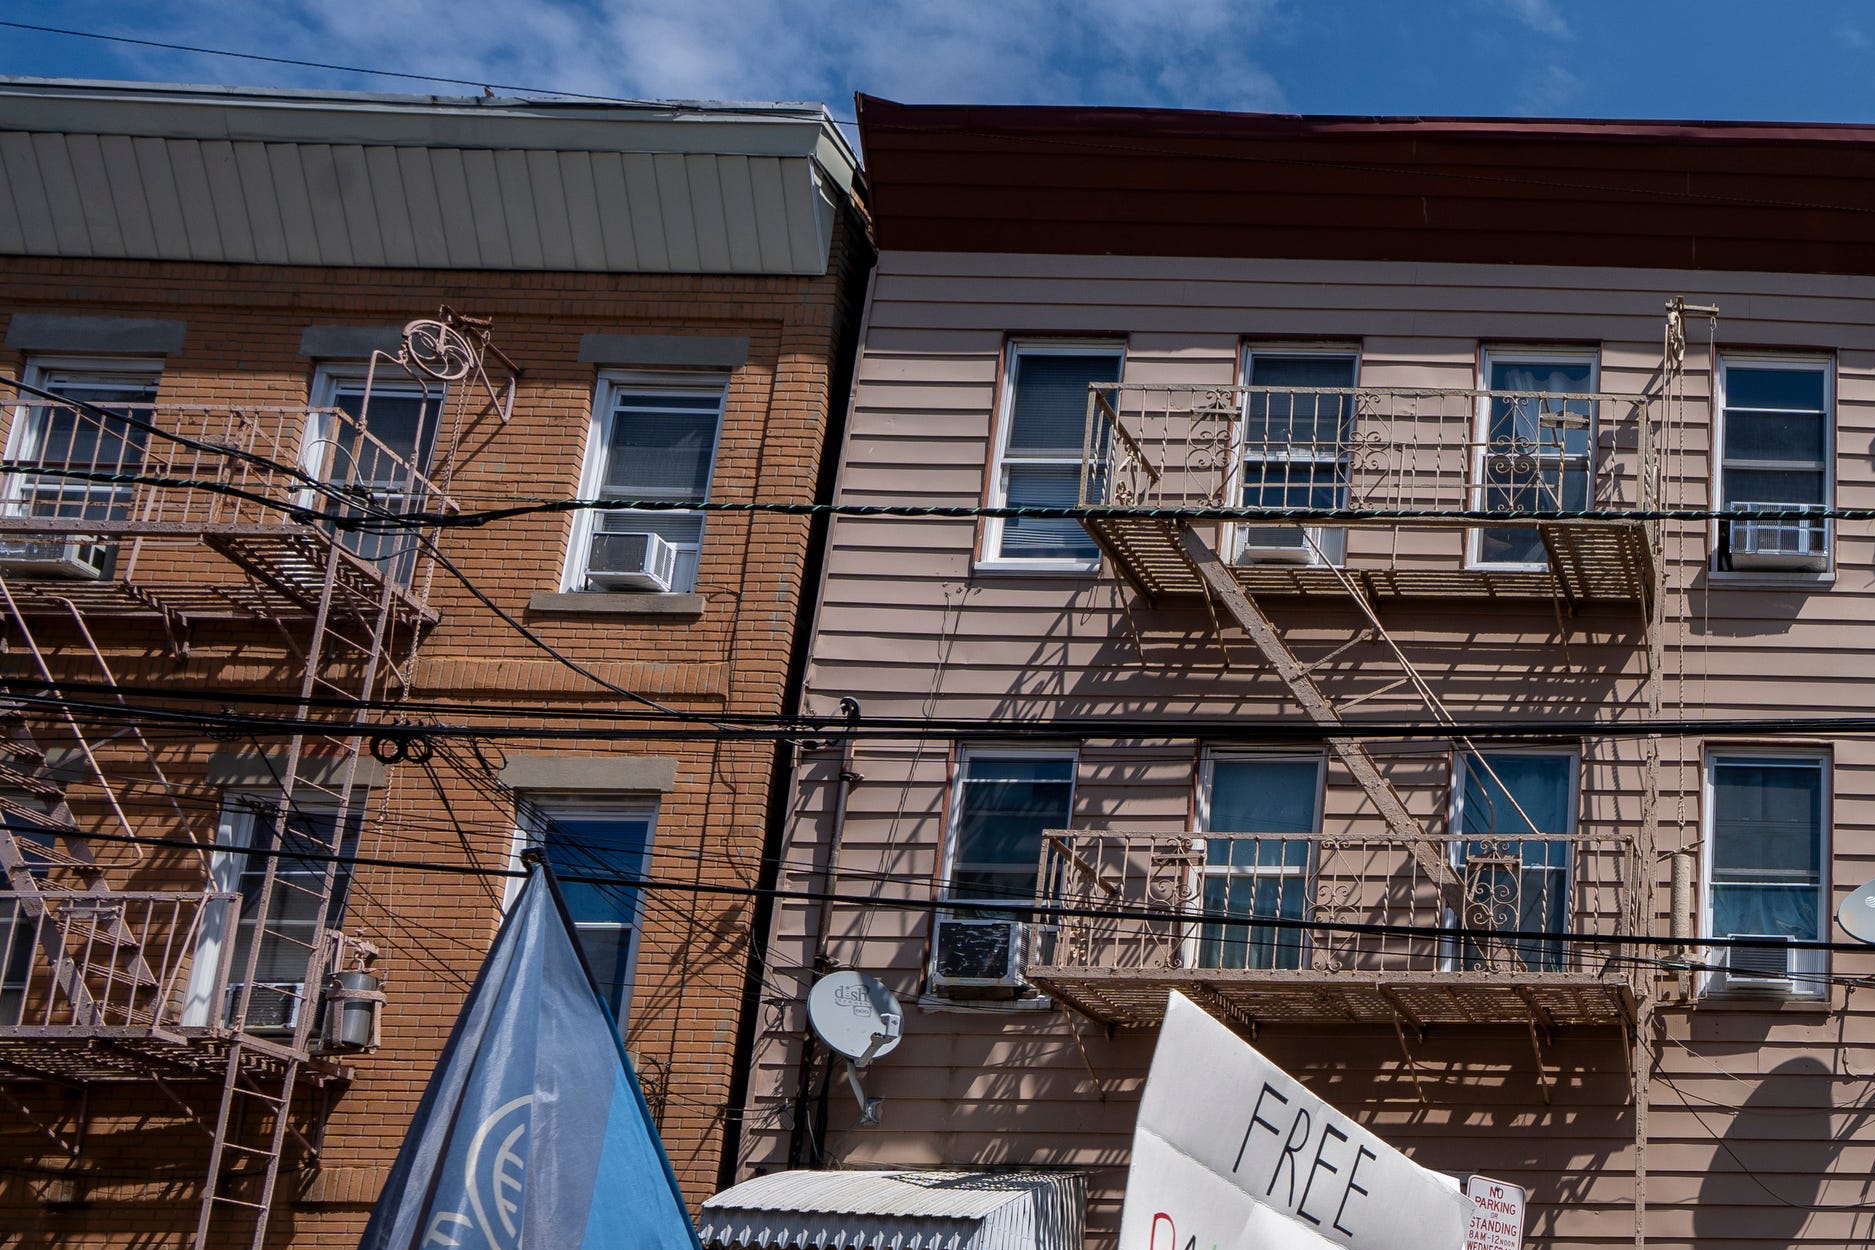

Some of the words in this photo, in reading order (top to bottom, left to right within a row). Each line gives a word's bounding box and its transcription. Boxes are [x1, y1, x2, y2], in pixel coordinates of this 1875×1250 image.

[835, 985, 868, 1002] dish
[1232, 1080, 1378, 1238] FREE
[1489, 1186, 1504, 1200] NO
[1474, 1195, 1516, 1216] PARKING
[1469, 1216, 1517, 1237] STANDING
